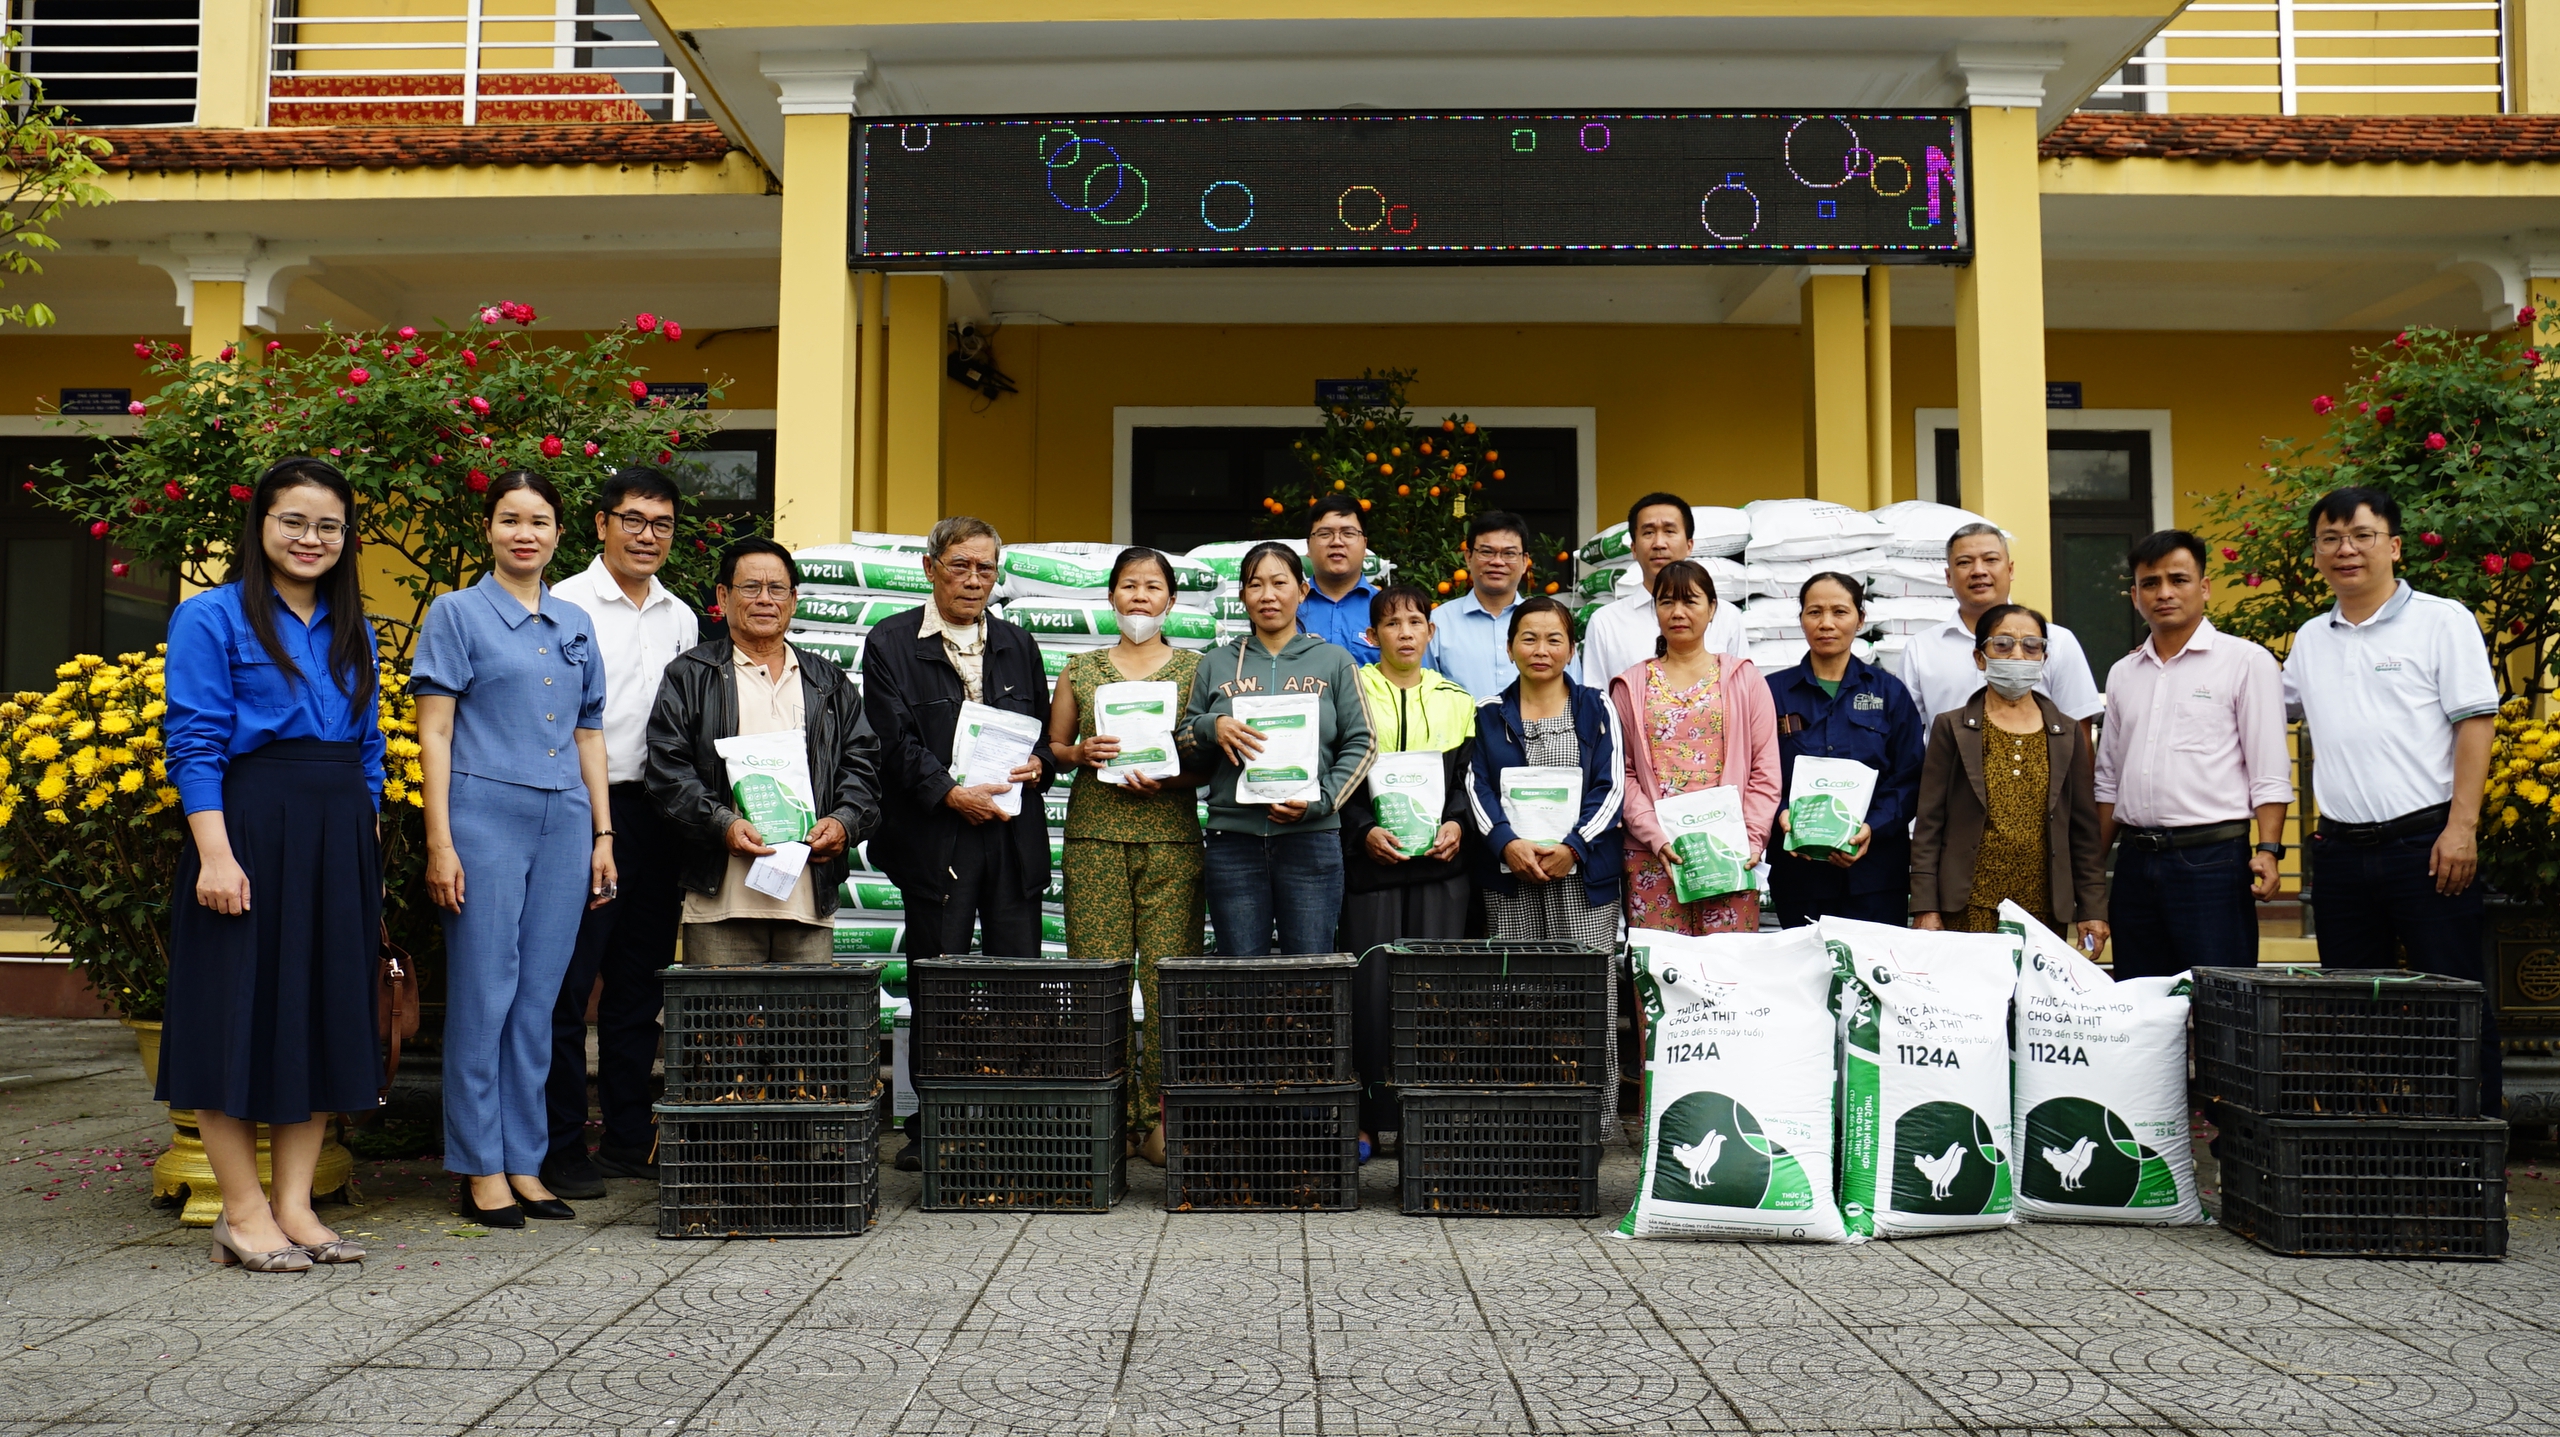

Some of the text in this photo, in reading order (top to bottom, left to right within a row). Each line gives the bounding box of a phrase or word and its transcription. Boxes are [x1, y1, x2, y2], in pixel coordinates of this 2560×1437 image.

[801, 563, 845, 579] 1124A
[806, 601, 849, 618] 1124A
[1029, 612, 1075, 628] 1124A
[1282, 676, 1328, 698] ART
[1676, 1002, 1700, 1017] THỨC
[1702, 998, 1716, 1010] ĂN
[1922, 1002, 1939, 1016] ĂN
[2030, 995, 2059, 1008] THỨC
[2110, 1003, 2134, 1015] HỢP
[1669, 1010, 1738, 1026] CHO GÀ THỊT
[1897, 1015, 1964, 1032] CH GÀ THỊT
[2028, 1010, 2102, 1028] CHO GÀ THỊT
[1680, 1030, 1690, 1038] 29
[1690, 1027, 1706, 1037] đến
[1708, 1028, 1718, 1036] 55
[1720, 1028, 1741, 1040] ngày
[1914, 1031, 1925, 1039] 29
[1942, 1035, 1952, 1044] 55
[2042, 1028, 2053, 1037] 29
[2054, 1030, 2072, 1039] đến
[2073, 1032, 2084, 1040] 55
[2086, 1034, 2108, 1045] ngày
[1666, 1042, 1721, 1065] 1124A
[1897, 1044, 1961, 1070] 1124A
[2029, 1042, 2090, 1067] 1124A
[1864, 1094, 1873, 1118] THỨC
[1786, 1126, 1812, 1140] 25 kg
[1854, 1106, 1864, 1157] CHO GÀ THỊT
[2155, 1128, 2166, 1136] 25
[1861, 1151, 1870, 1170] HỢP
[1782, 1191, 1800, 1199] THỨC
[1775, 1200, 1794, 1208] DẠNG
